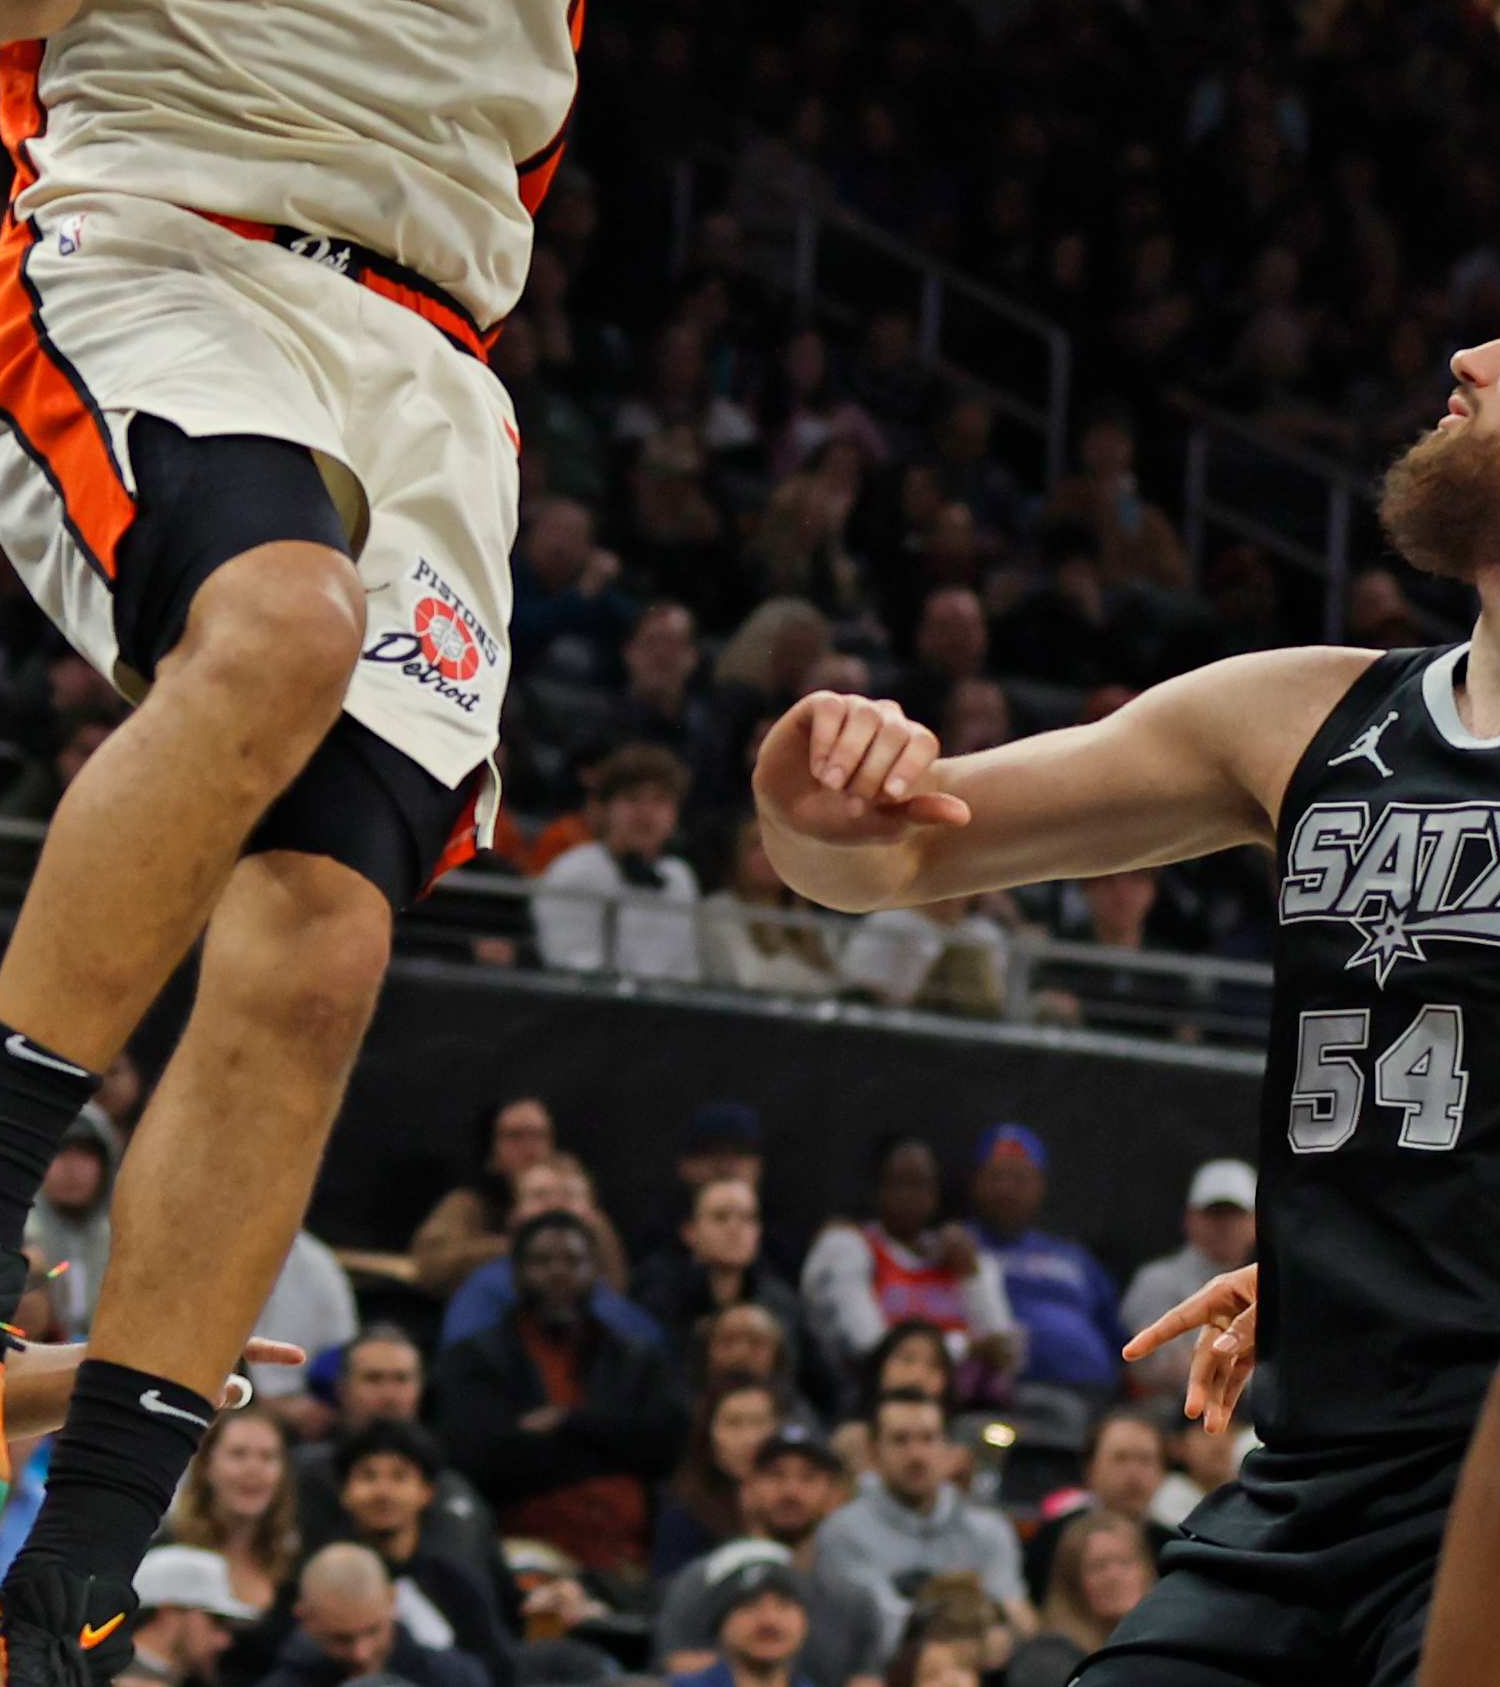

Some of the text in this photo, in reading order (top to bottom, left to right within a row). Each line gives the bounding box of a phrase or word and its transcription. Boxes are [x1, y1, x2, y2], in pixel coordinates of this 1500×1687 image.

[411, 557, 498, 668] PISTONS
[362, 632, 481, 713] Detroit
[1287, 1004, 1470, 1154] 54
